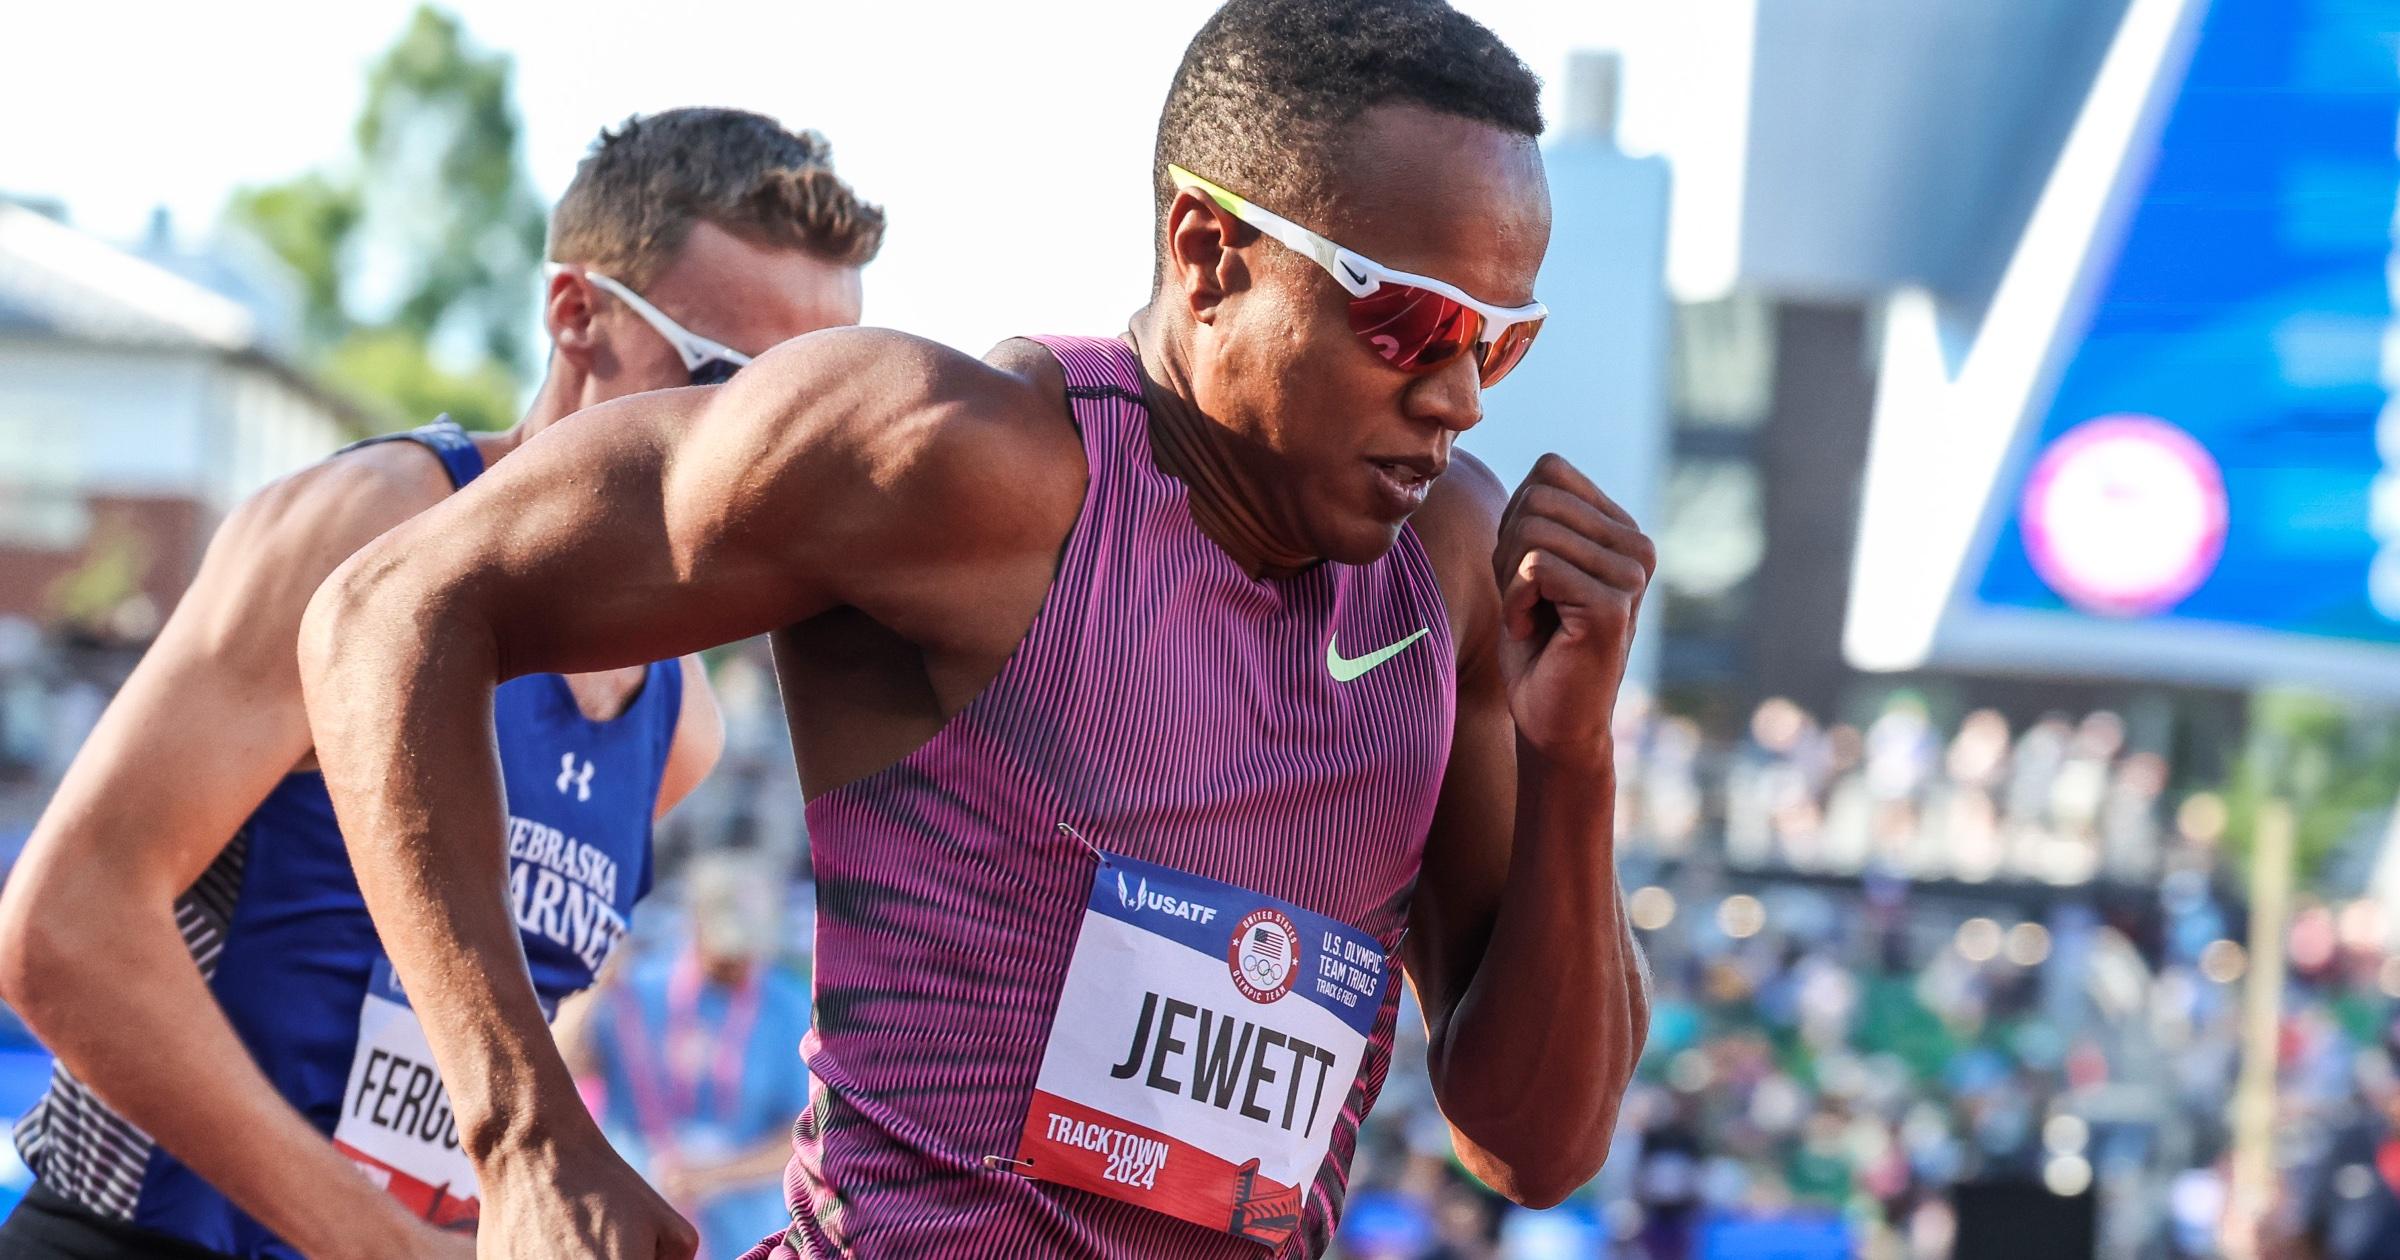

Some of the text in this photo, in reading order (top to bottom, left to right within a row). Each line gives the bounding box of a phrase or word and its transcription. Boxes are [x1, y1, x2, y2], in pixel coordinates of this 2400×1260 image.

[509, 816, 617, 906] EBRASKA
[1147, 891, 1217, 925] USATF
[1242, 911, 1297, 944] UNITED STATES
[1322, 931, 1382, 975] U.S. OLYMPIC
[1232, 969, 1287, 1001] OLYMPIC TEAM
[1316, 978, 1339, 999] TRACK
[1341, 989, 1358, 1008] FIELD
[1319, 954, 1377, 997] TEAM TRIALS
[1110, 992, 1336, 1139] JEWETT
[1046, 1113, 1169, 1169] TRACKTOWN
[1102, 1153, 1158, 1190] 2024
